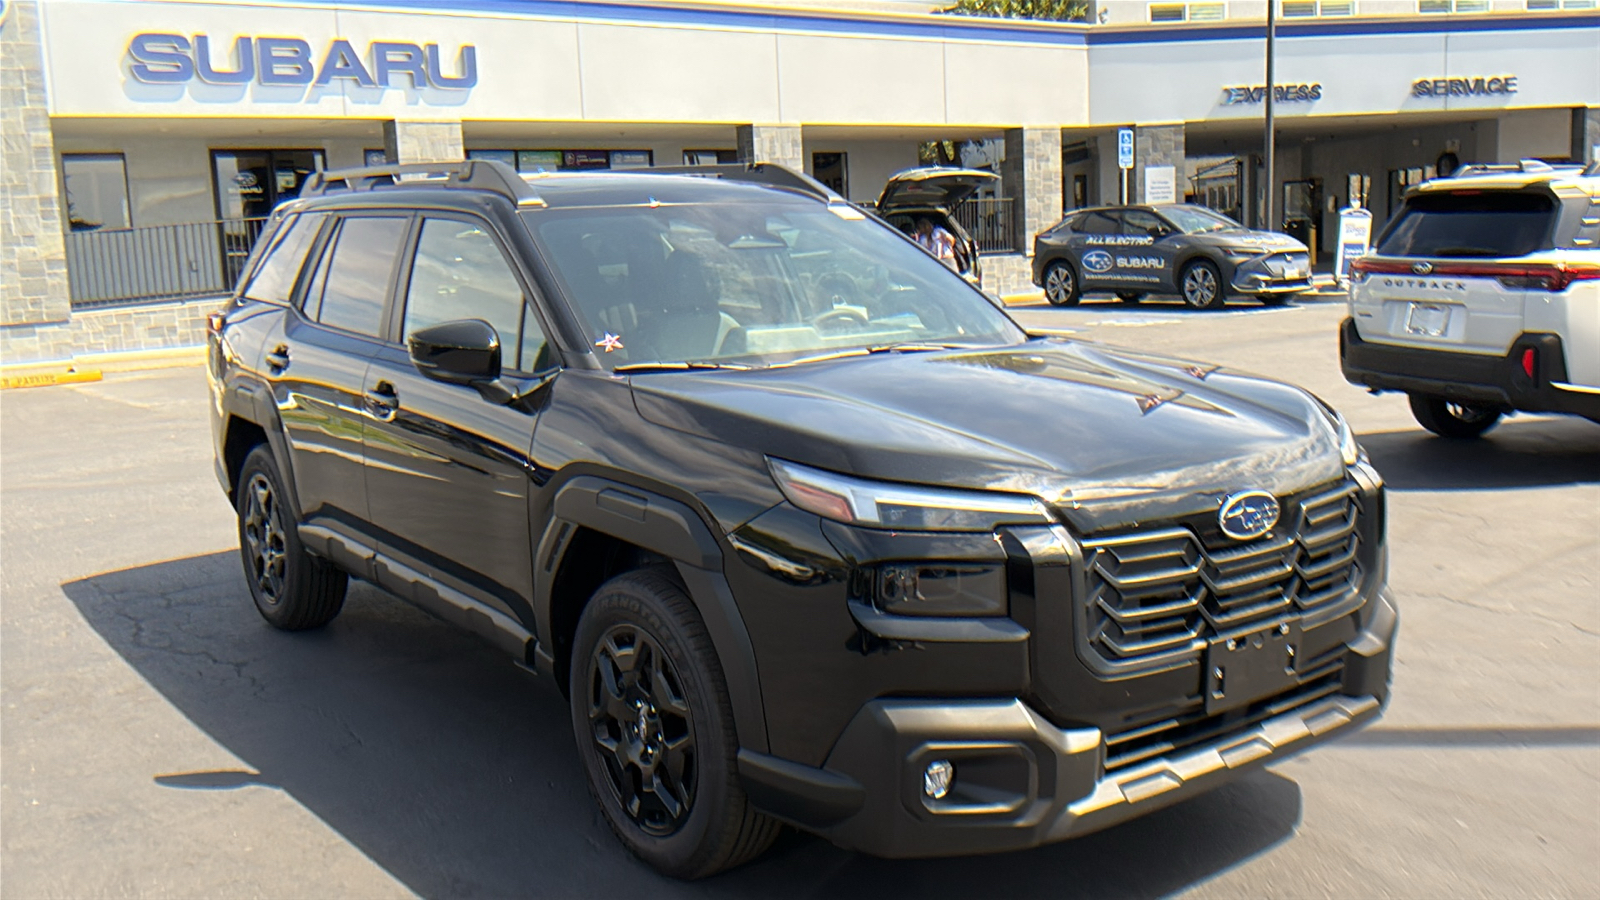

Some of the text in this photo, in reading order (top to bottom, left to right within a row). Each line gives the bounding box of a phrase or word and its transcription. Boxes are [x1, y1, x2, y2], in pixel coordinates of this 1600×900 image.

[127, 32, 478, 90] SUBARU
[1222, 84, 1322, 104] EXPRESS
[1413, 76, 1517, 98] SERVICE
[1086, 235, 1154, 247] ALL ELECTRIC
[1116, 256, 1165, 269] SUBARU
[1384, 279, 1466, 291] OUTBACK
